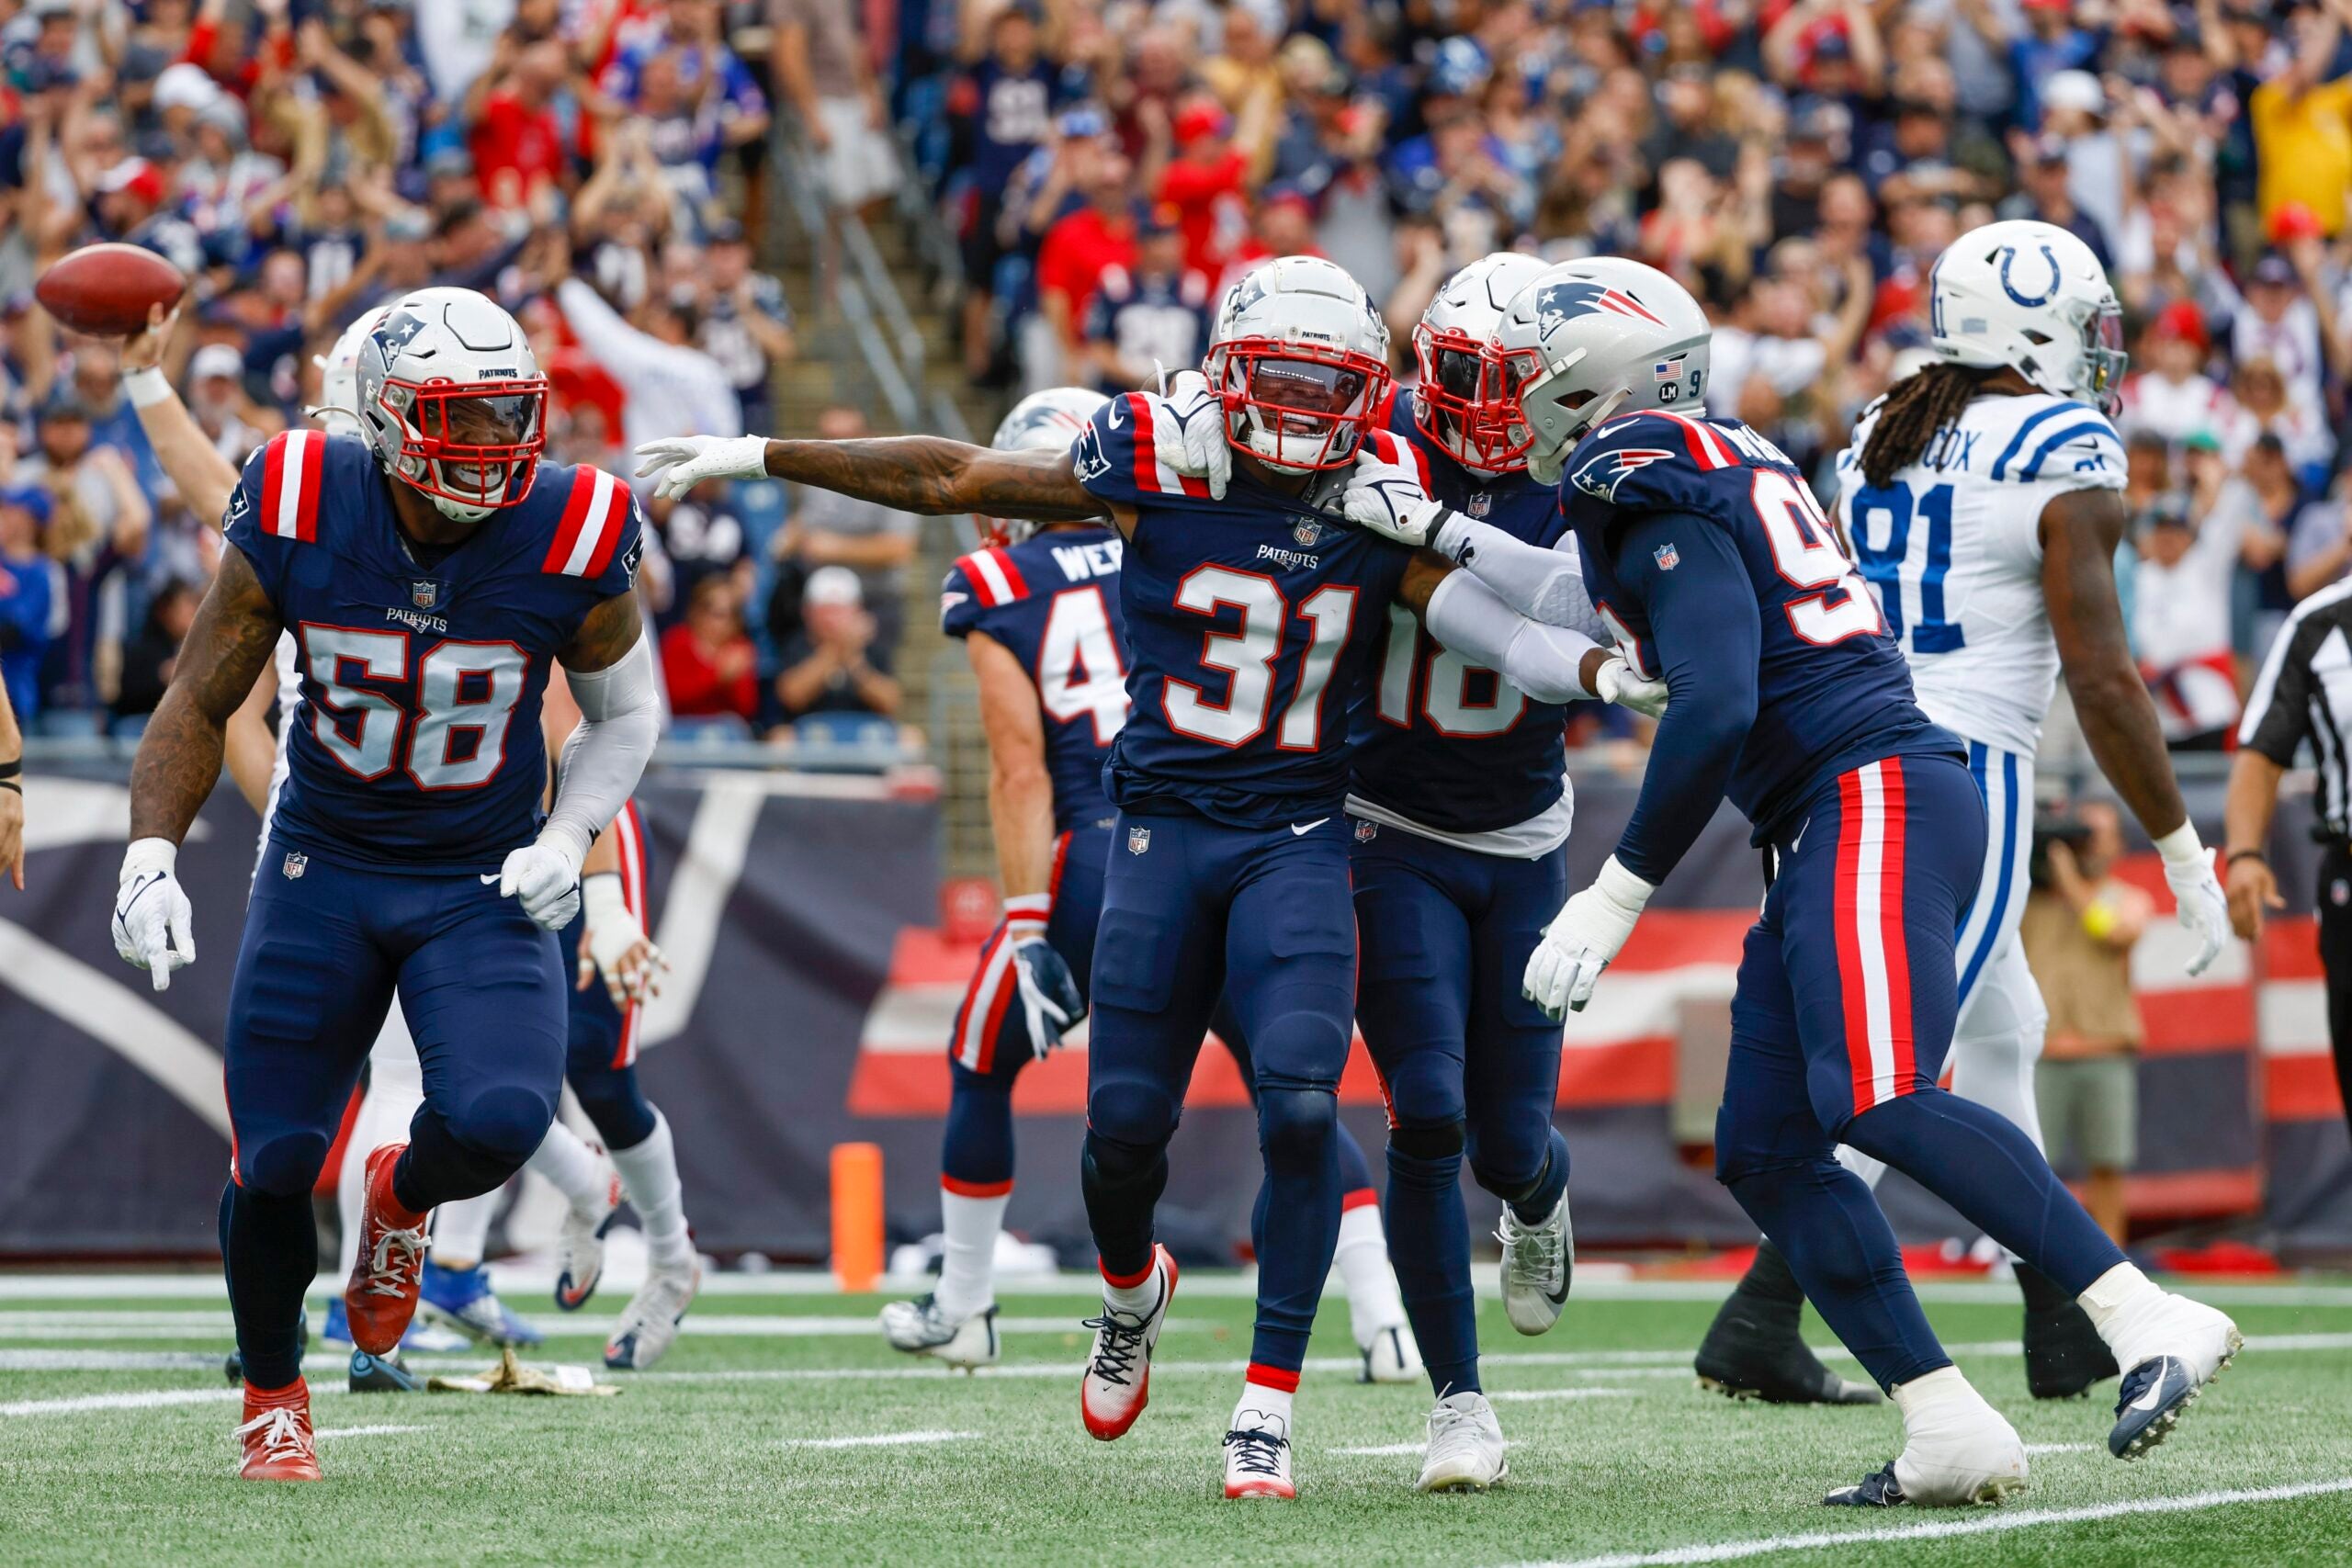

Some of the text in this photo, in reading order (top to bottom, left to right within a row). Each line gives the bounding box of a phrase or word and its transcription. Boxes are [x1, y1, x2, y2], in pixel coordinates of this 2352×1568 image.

[1302, 331, 1331, 342] PATRIOTS
[479, 368, 518, 380] PATRIOTS
[1661, 386, 1678, 400] LM
[1923, 427, 1982, 471] COX
[1256, 544, 1319, 570] PATRIOTS
[1750, 467, 1883, 647] 9
[1851, 479, 1966, 654] 91
[386, 607, 448, 633] PATRIOTS
[1160, 561, 1361, 753] 31
[1375, 600, 1530, 740] 18
[298, 619, 532, 792] 58
